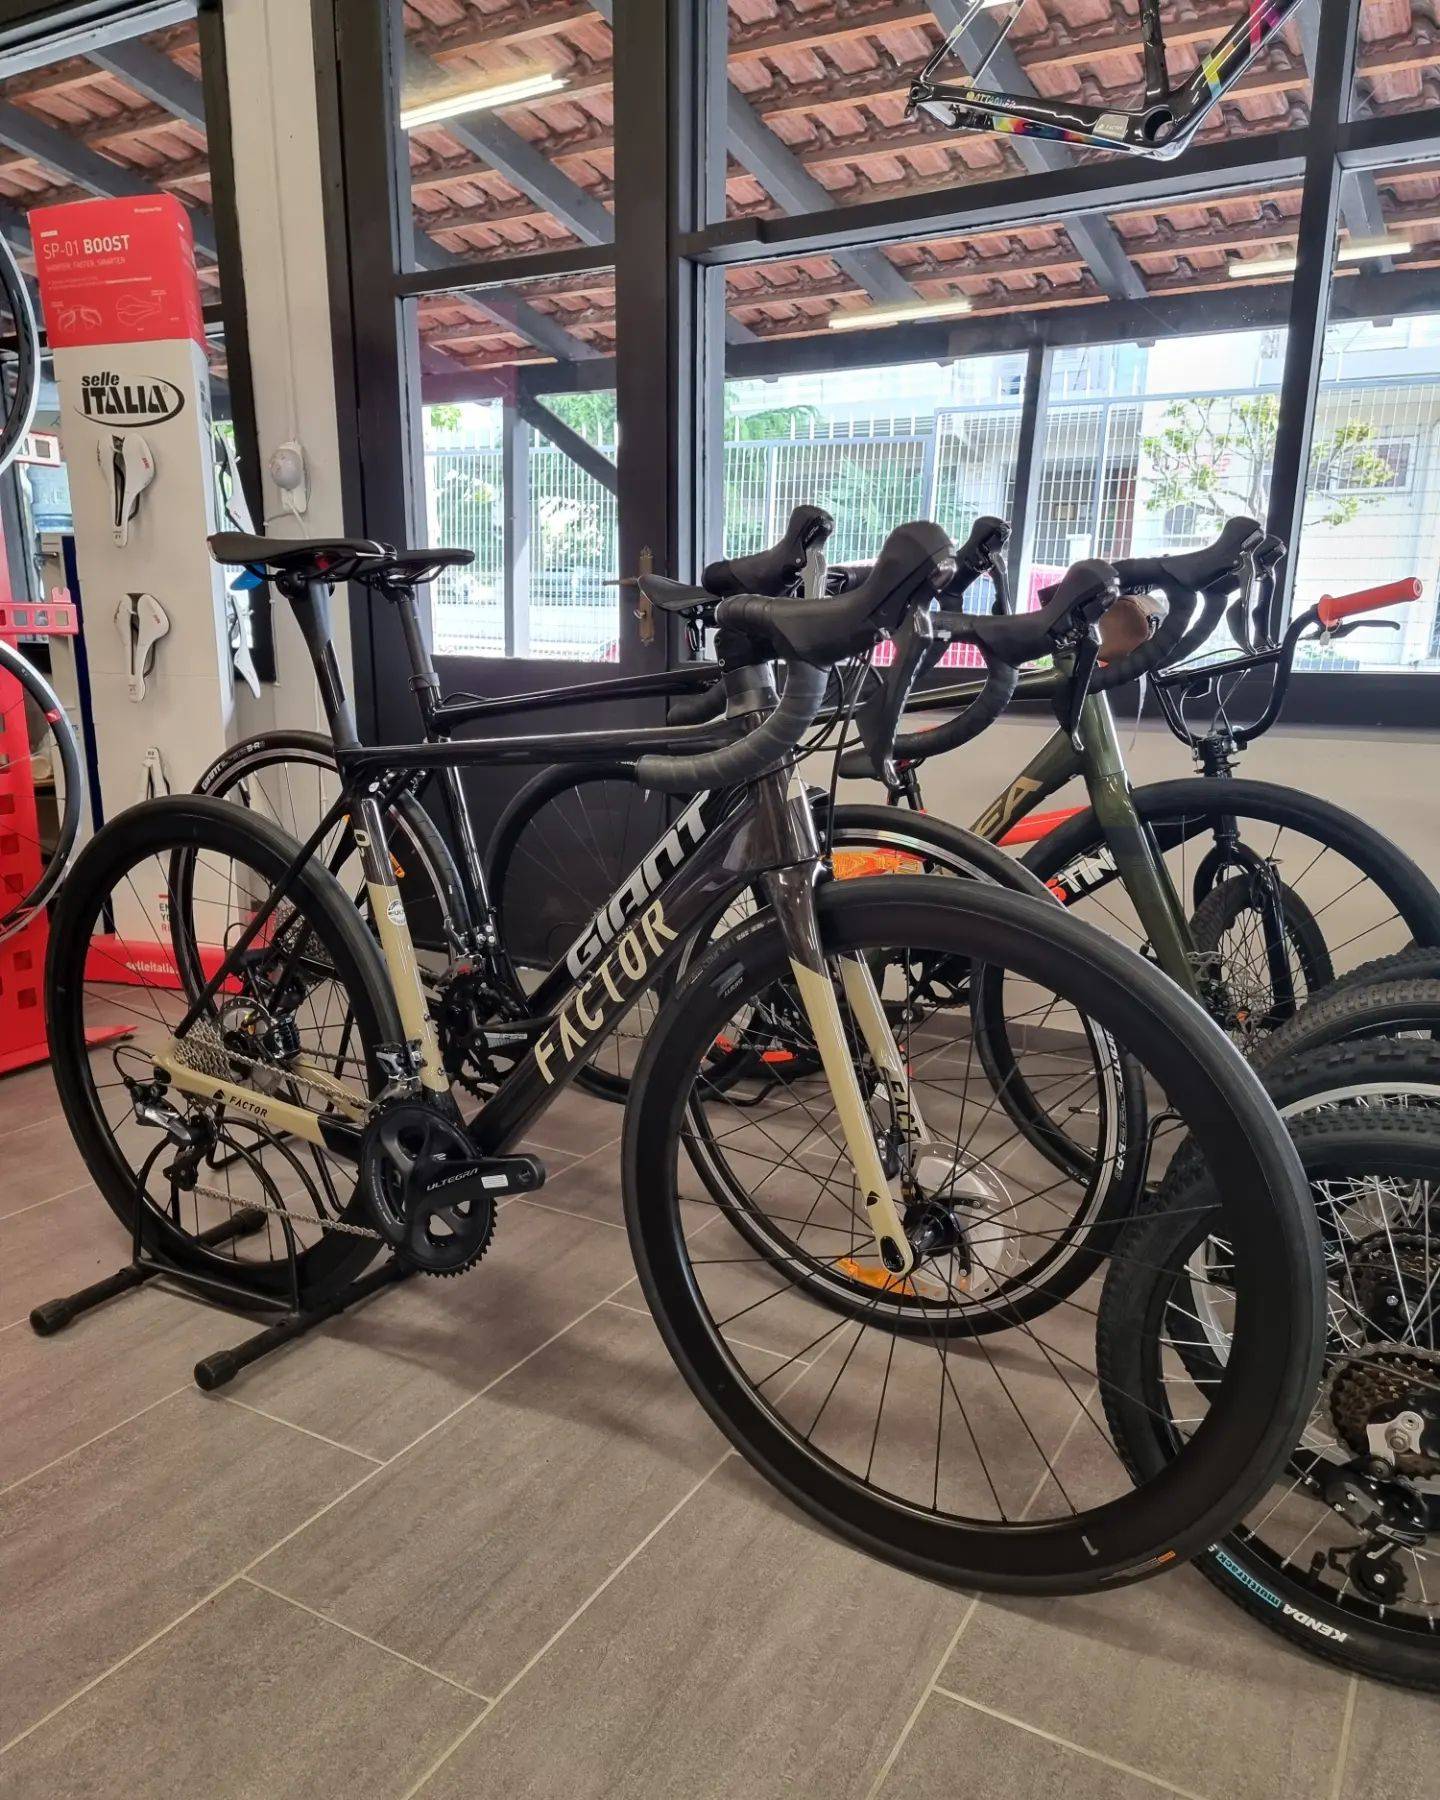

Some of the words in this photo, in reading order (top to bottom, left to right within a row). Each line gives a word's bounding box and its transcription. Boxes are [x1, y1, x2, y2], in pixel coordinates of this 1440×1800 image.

[43, 240, 79, 260] SP-01
[83, 234, 130, 254] BOOST
[81, 371, 120, 386] selle
[82, 385, 169, 415] ITALIA
[566, 789, 711, 979] GIANT
[534, 899, 679, 1084] FACTOR
[229, 1096, 268, 1118] FACTOR
[890, 1080, 922, 1139] FACT
[426, 1167, 479, 1191] ULTEGRA
[1282, 1602, 1349, 1643] KENDA
